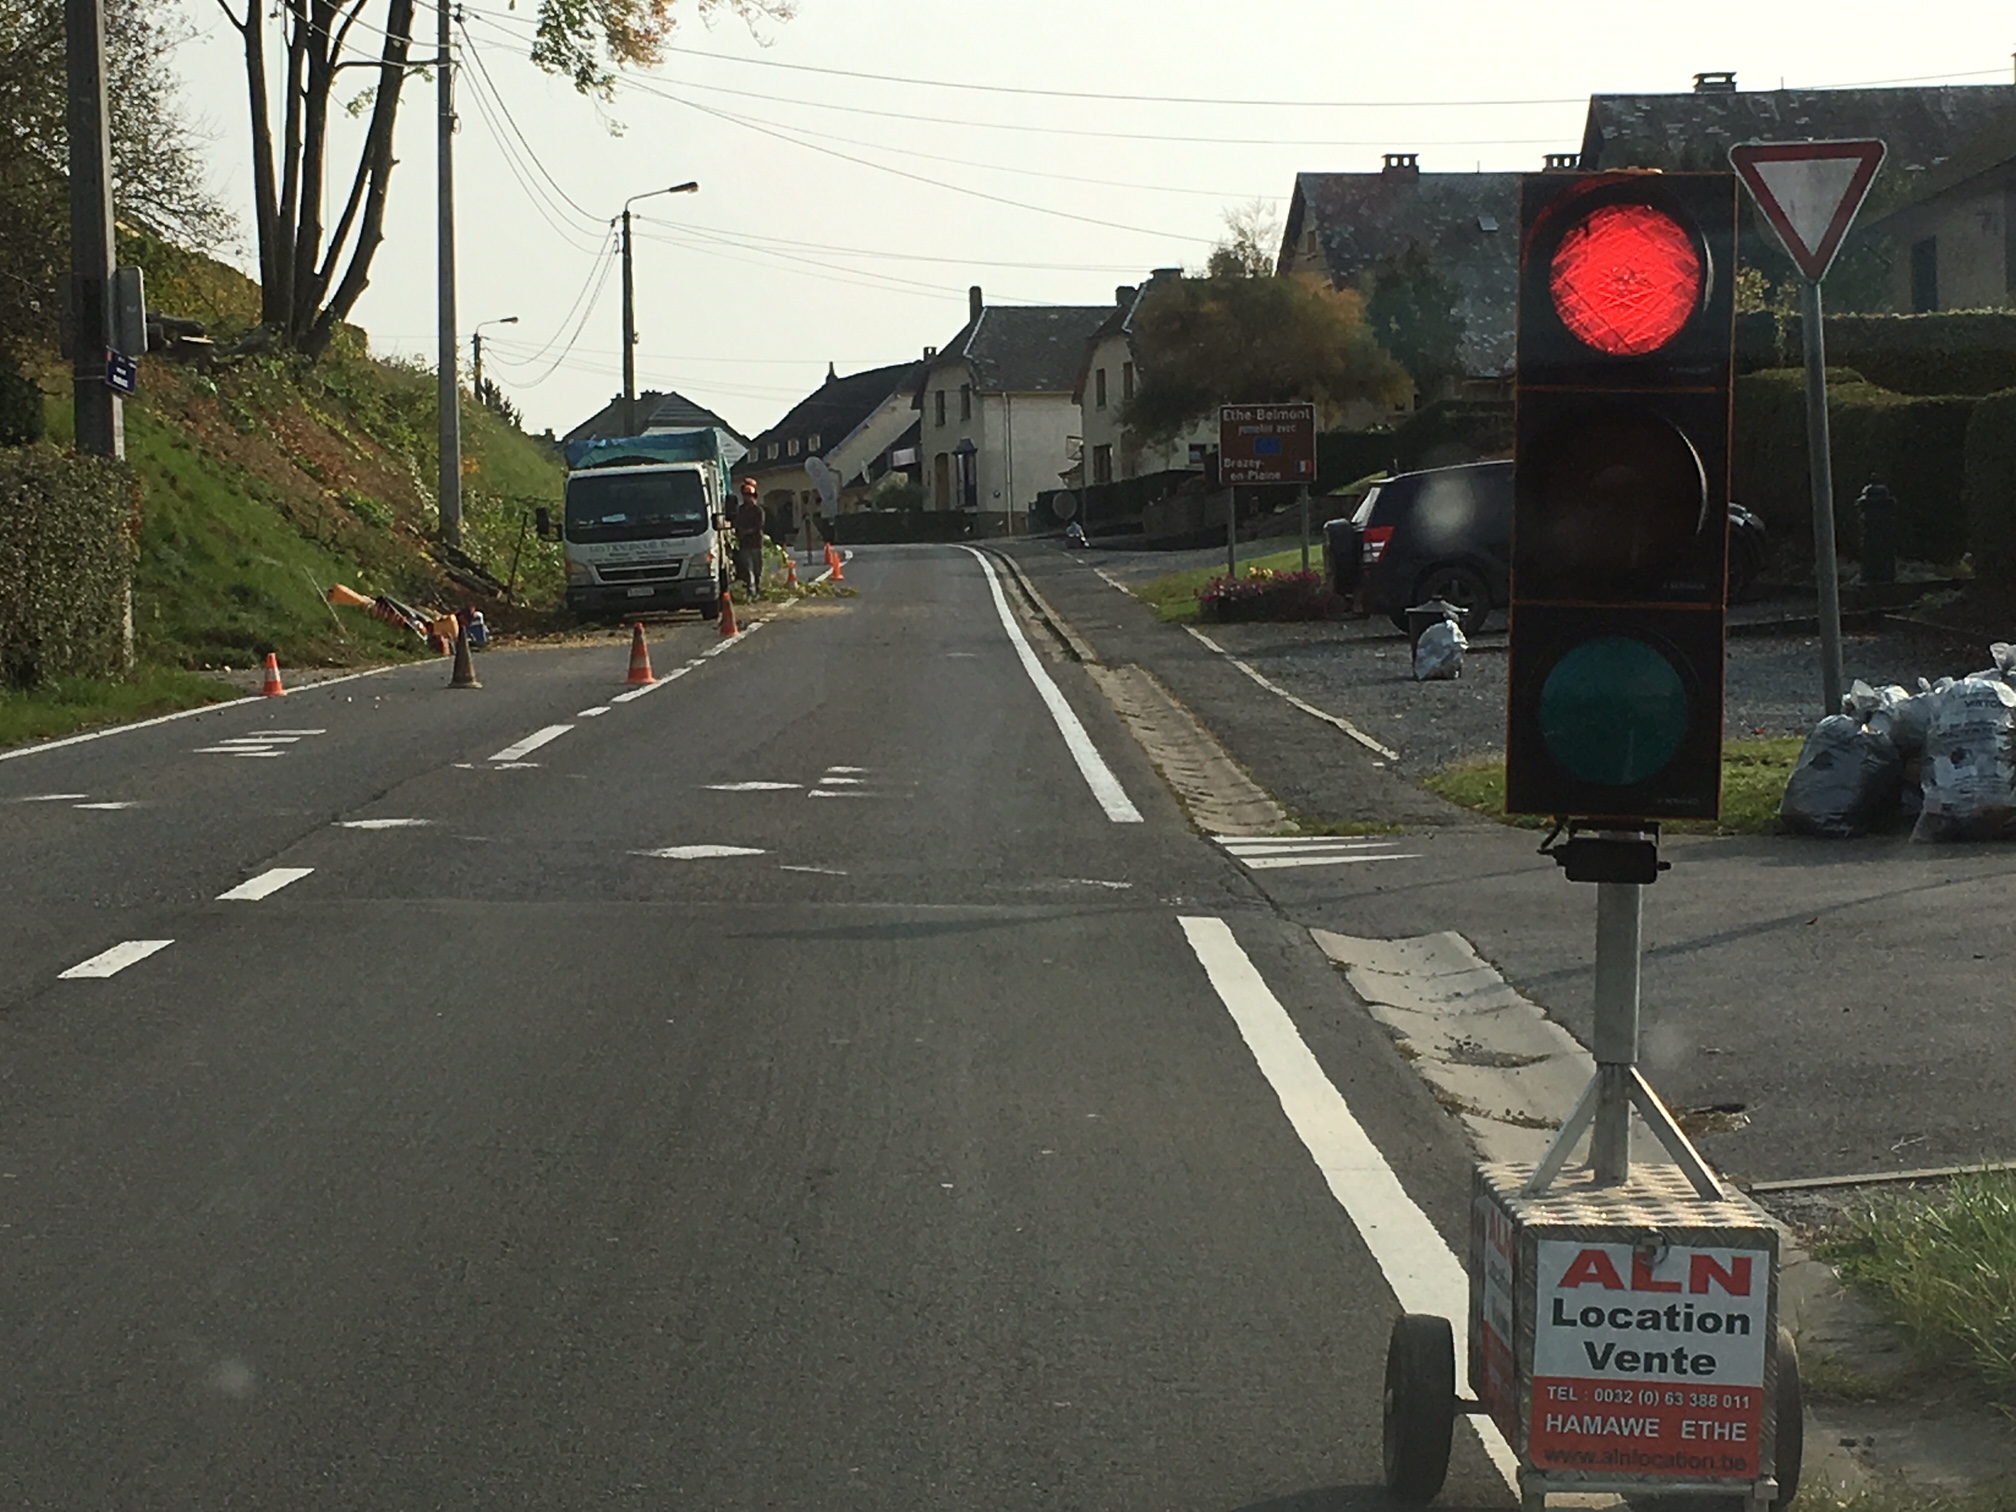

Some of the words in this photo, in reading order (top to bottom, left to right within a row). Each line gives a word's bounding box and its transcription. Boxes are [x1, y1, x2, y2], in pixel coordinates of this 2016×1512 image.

[1964, 699, 2001, 708] VIRTO
[1557, 1248, 1752, 1296] ALN
[1552, 1298, 1750, 1335] Location
[1583, 1341, 1717, 1375] Vente
[1594, 1388, 1633, 1404] 0032
[1638, 1389, 1659, 1407] (0)
[1689, 1393, 1718, 1408] 388
[1722, 1395, 1750, 1409] 011
[1545, 1413, 1660, 1439] HAMAWE
[1680, 1419, 1748, 1442] ETHE
[1544, 1448, 1748, 1472] www.alnlocation.be
